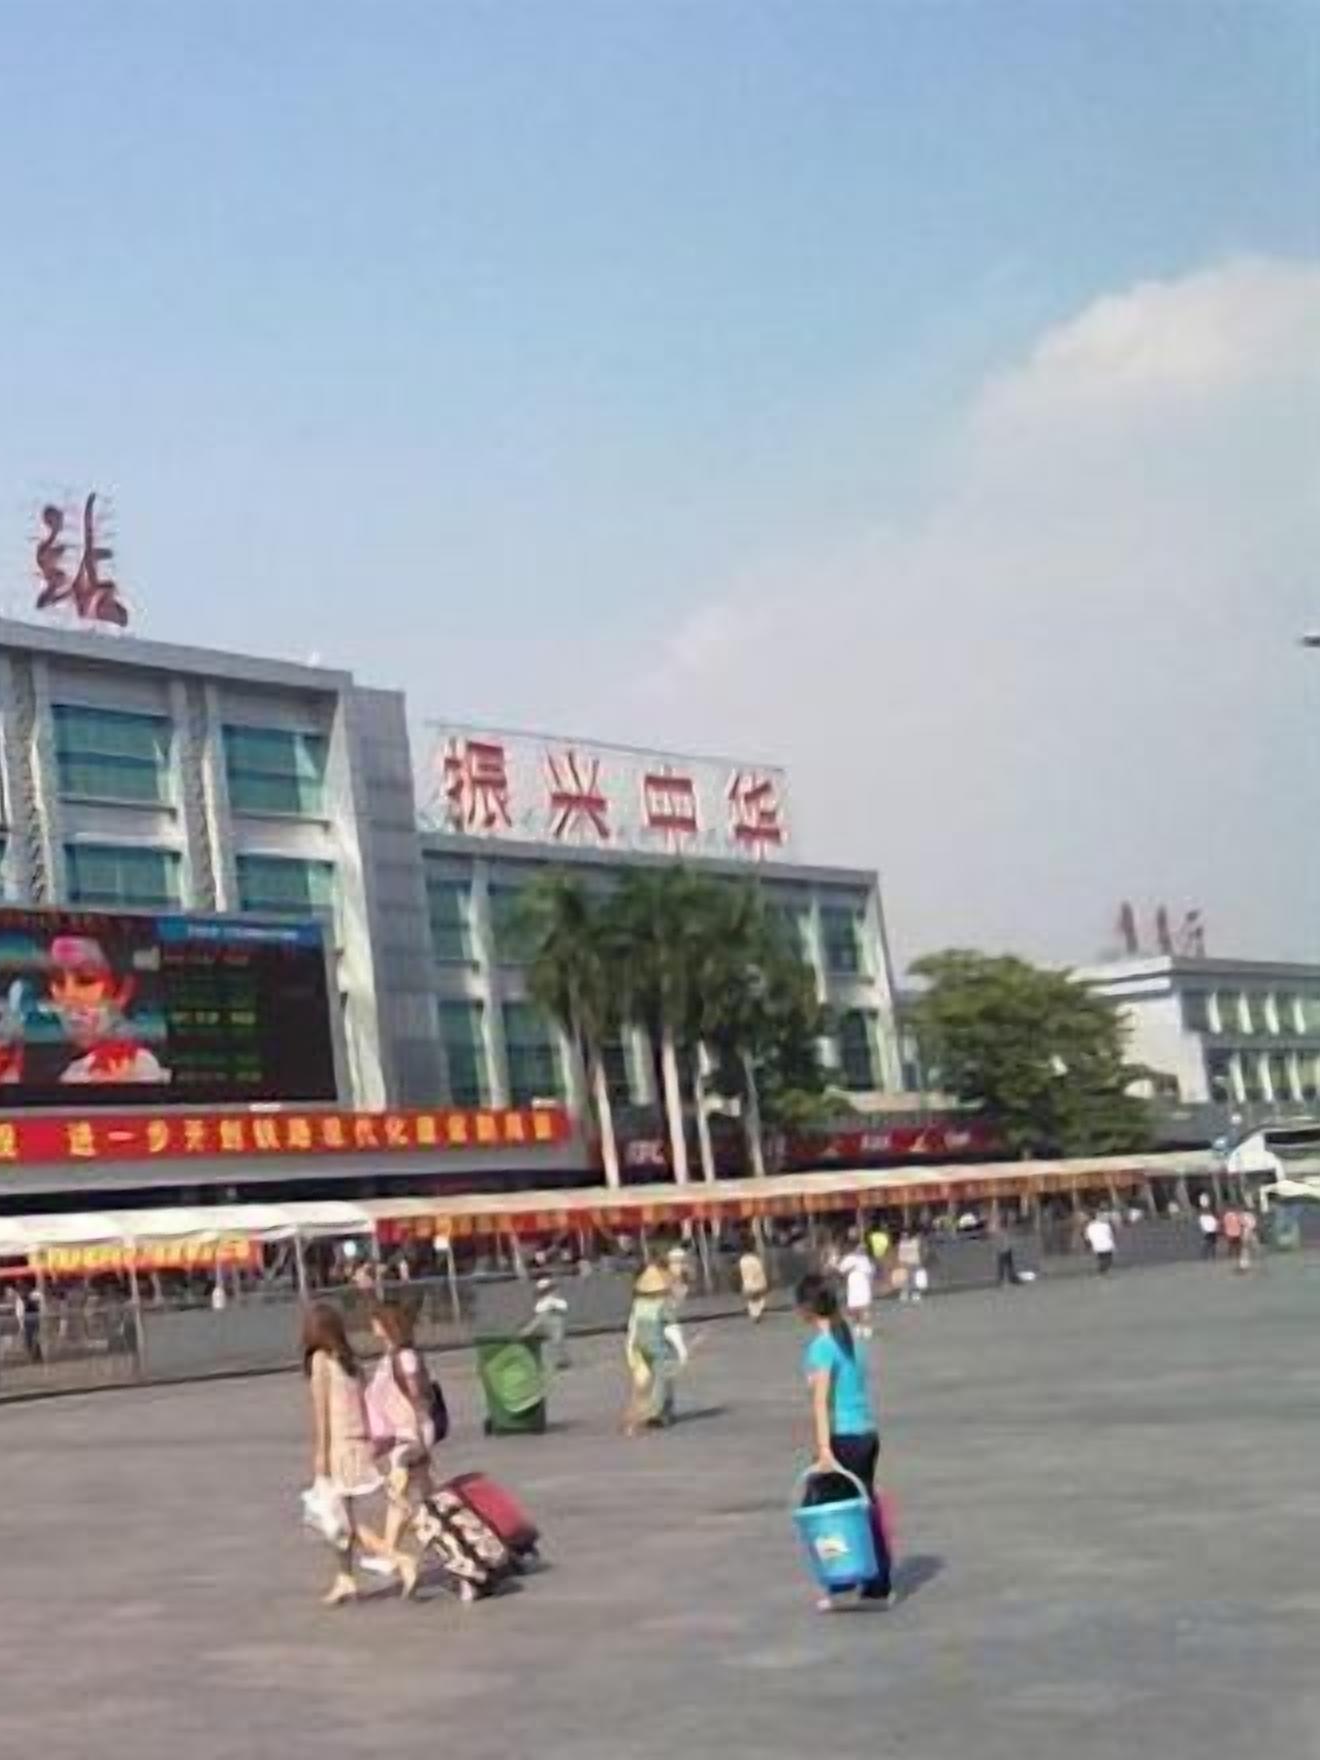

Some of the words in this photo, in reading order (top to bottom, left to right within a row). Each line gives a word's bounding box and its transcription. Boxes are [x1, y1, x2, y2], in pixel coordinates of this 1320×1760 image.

[443, 738, 784, 862] 振兴中华
[66, 1113, 553, 1157] 进一步开创铁路现代化
